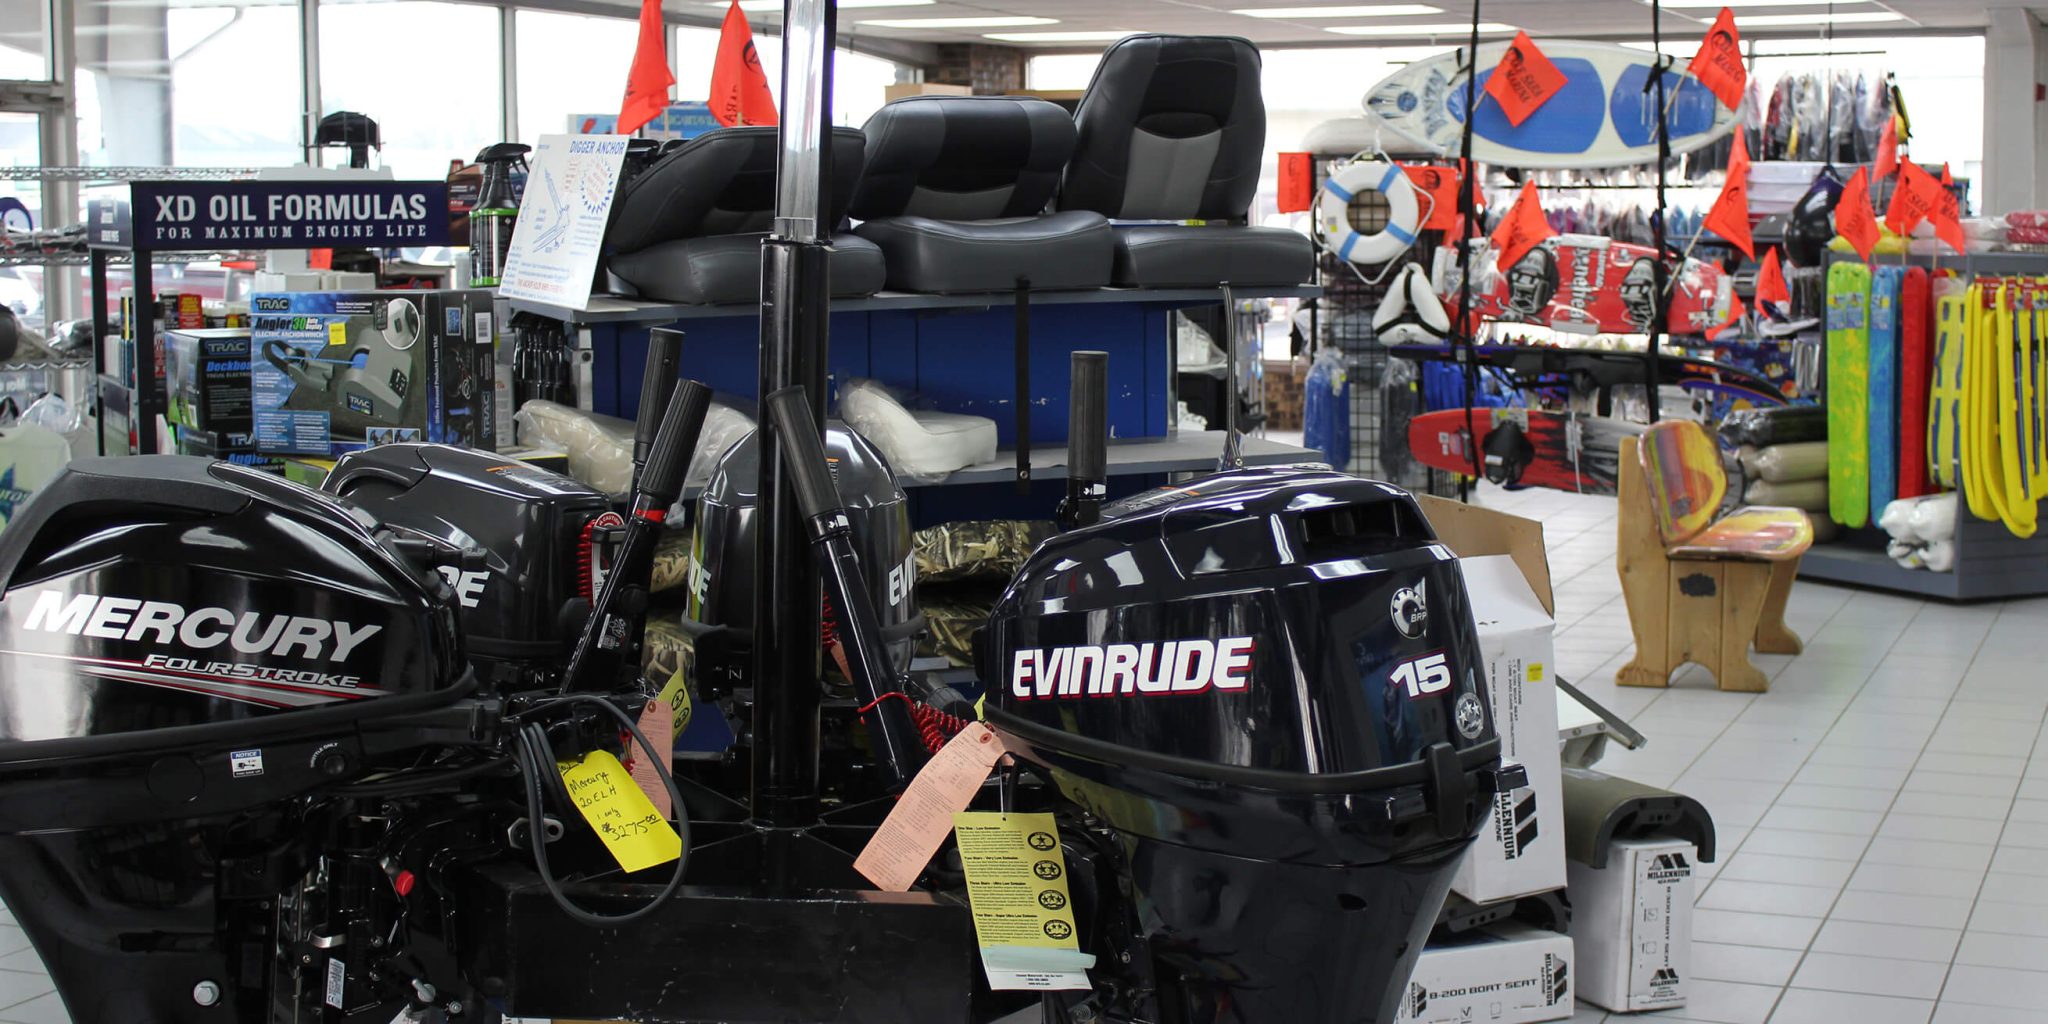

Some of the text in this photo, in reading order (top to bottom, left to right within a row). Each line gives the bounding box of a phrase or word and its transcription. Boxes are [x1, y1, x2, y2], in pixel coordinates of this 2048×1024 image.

[569, 140, 625, 155] DIGGER ANCHOR
[155, 195, 196, 222] XD
[209, 195, 257, 222] OIL
[268, 194, 427, 222] FORMULAS
[156, 224, 427, 240] FOR MAXIMUM ENGINE LIFE
[257, 299, 289, 310] TRAC
[255, 316, 306, 331] Angler 30
[208, 342, 246, 352] TRAC
[1410, 611, 1427, 623] BRP
[22, 590, 383, 663] MERCURY
[142, 653, 361, 689] FOURSTROKE
[1011, 636, 1255, 699] EVINRUDE
[1390, 652, 1451, 698] 15
[235, 751, 257, 759] NOTICE
[1647, 869, 1690, 881] MILLENNIUM
[1545, 953, 1553, 1007] MILLENNIUM
[1429, 978, 1538, 1000] B-200 BOAT SEAT
